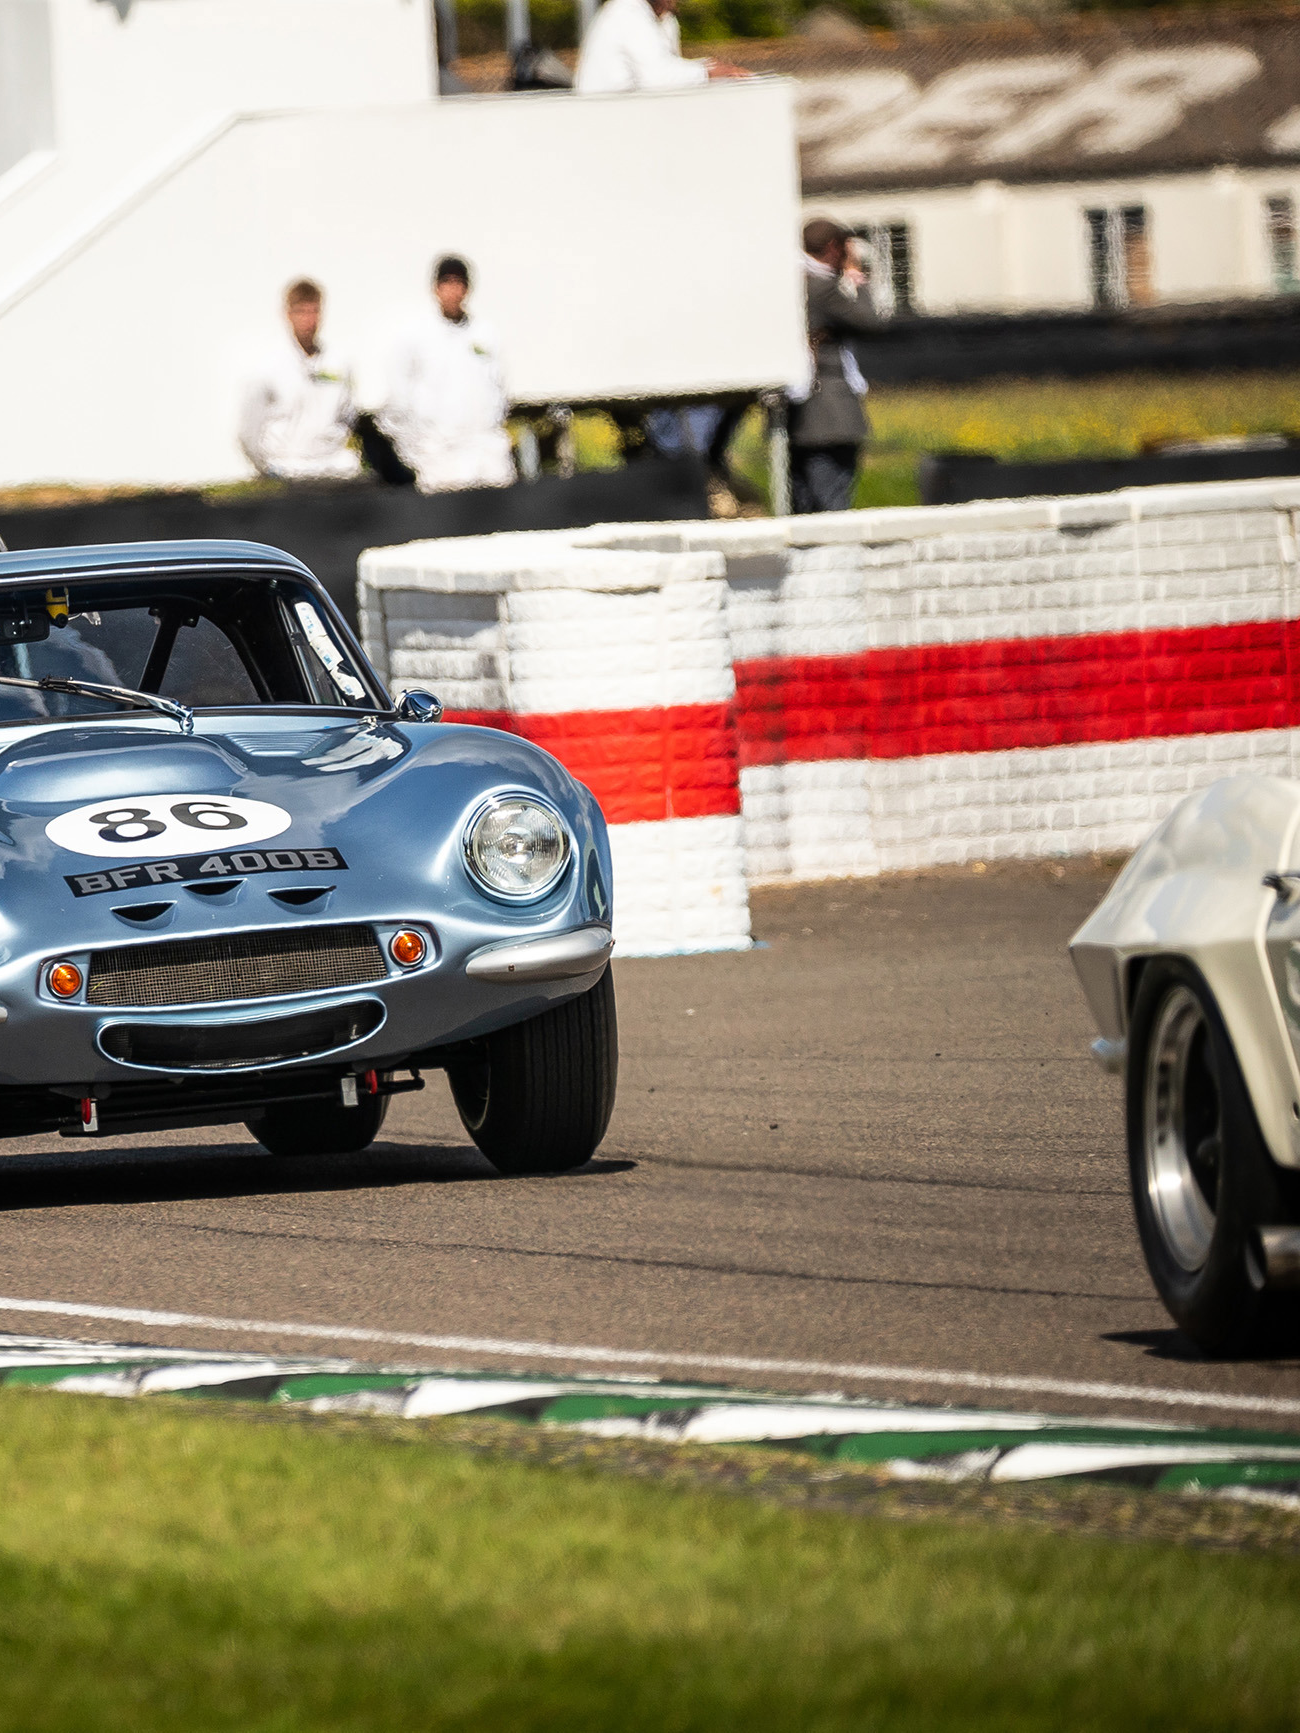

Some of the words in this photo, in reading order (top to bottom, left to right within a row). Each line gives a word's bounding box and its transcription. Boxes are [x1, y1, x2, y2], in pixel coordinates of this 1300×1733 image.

[89, 802, 248, 842] 86
[74, 862, 184, 894] BFR
[199, 850, 339, 874] 400B
